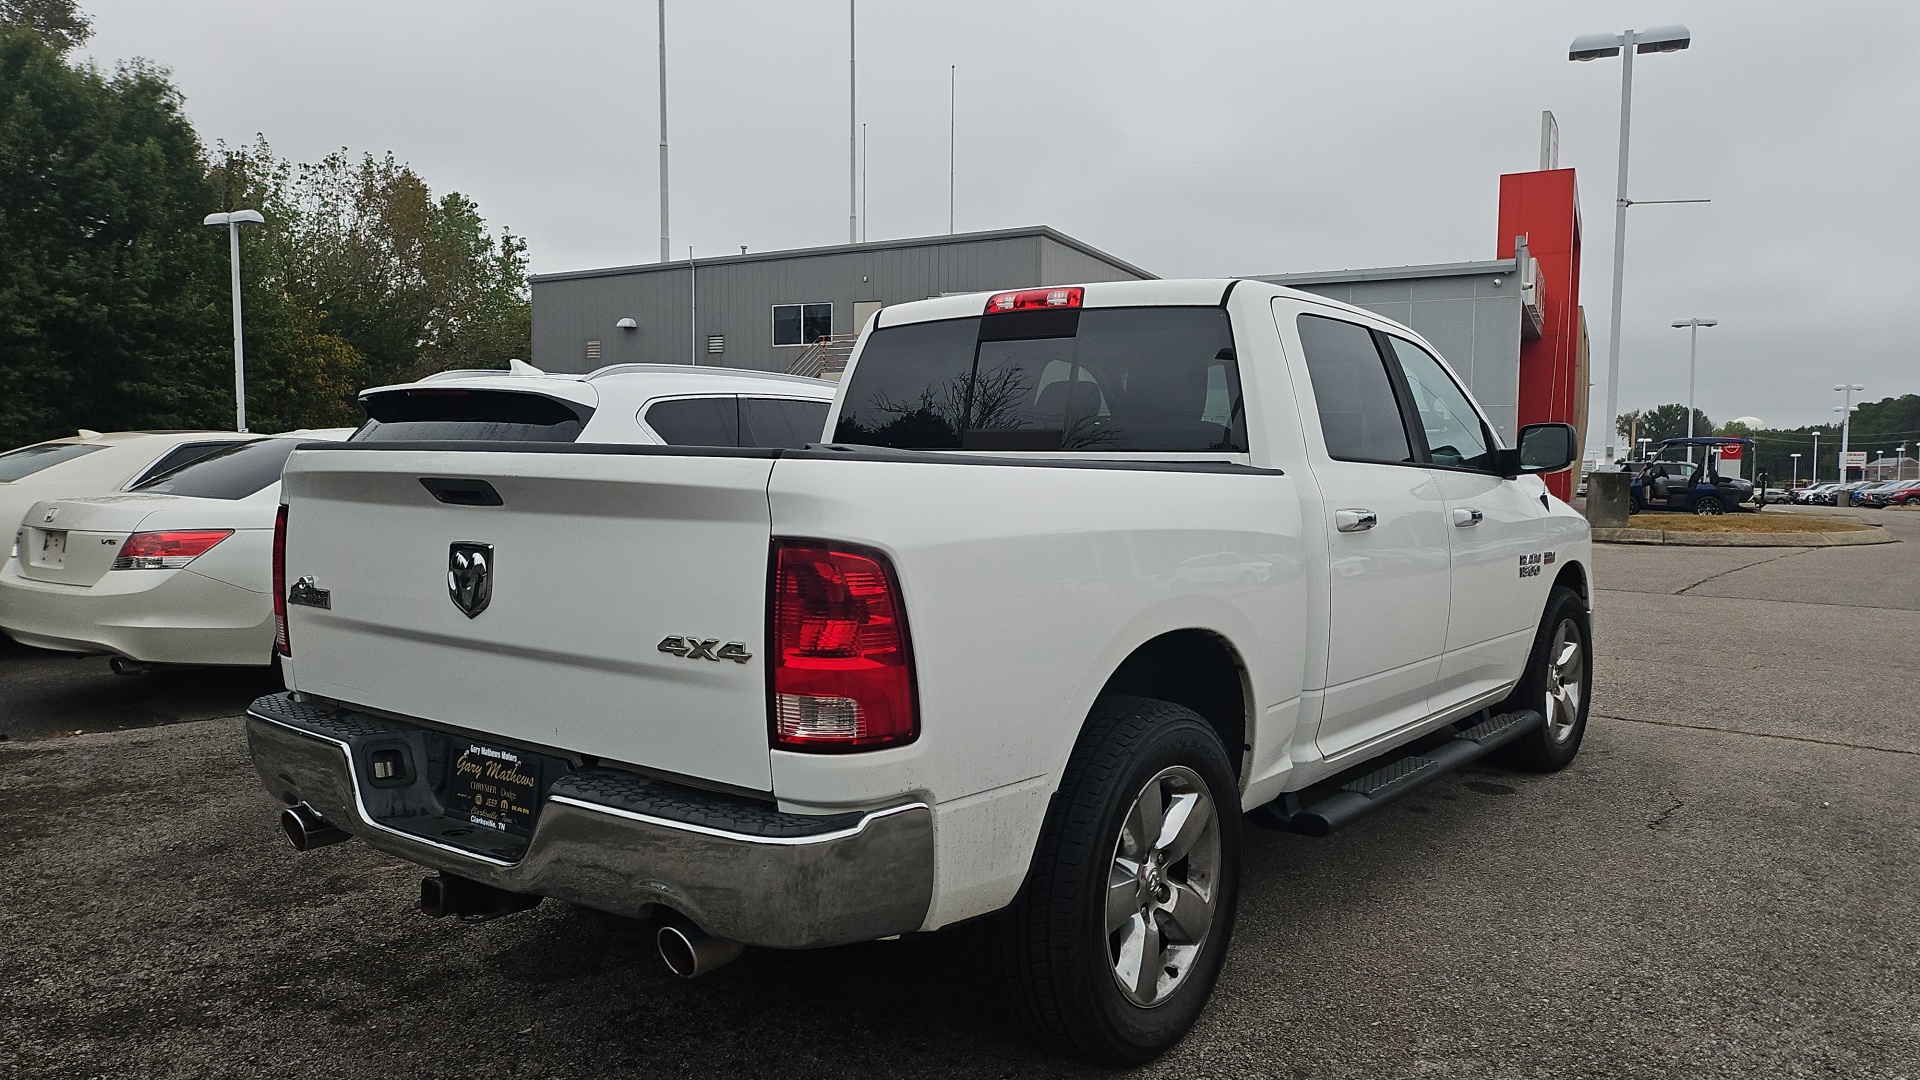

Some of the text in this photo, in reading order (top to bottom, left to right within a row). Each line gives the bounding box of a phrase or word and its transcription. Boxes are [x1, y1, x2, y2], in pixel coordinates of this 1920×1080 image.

[470, 744, 518, 762] Gary Mathews Motors
[456, 755, 535, 787] Gary Mathews
[470, 781, 517, 801] CHRYSLER Dodge
[485, 798, 498, 807] JEEP
[511, 805, 530, 815] RAM
[470, 815, 506, 831] Clarksville, TN
